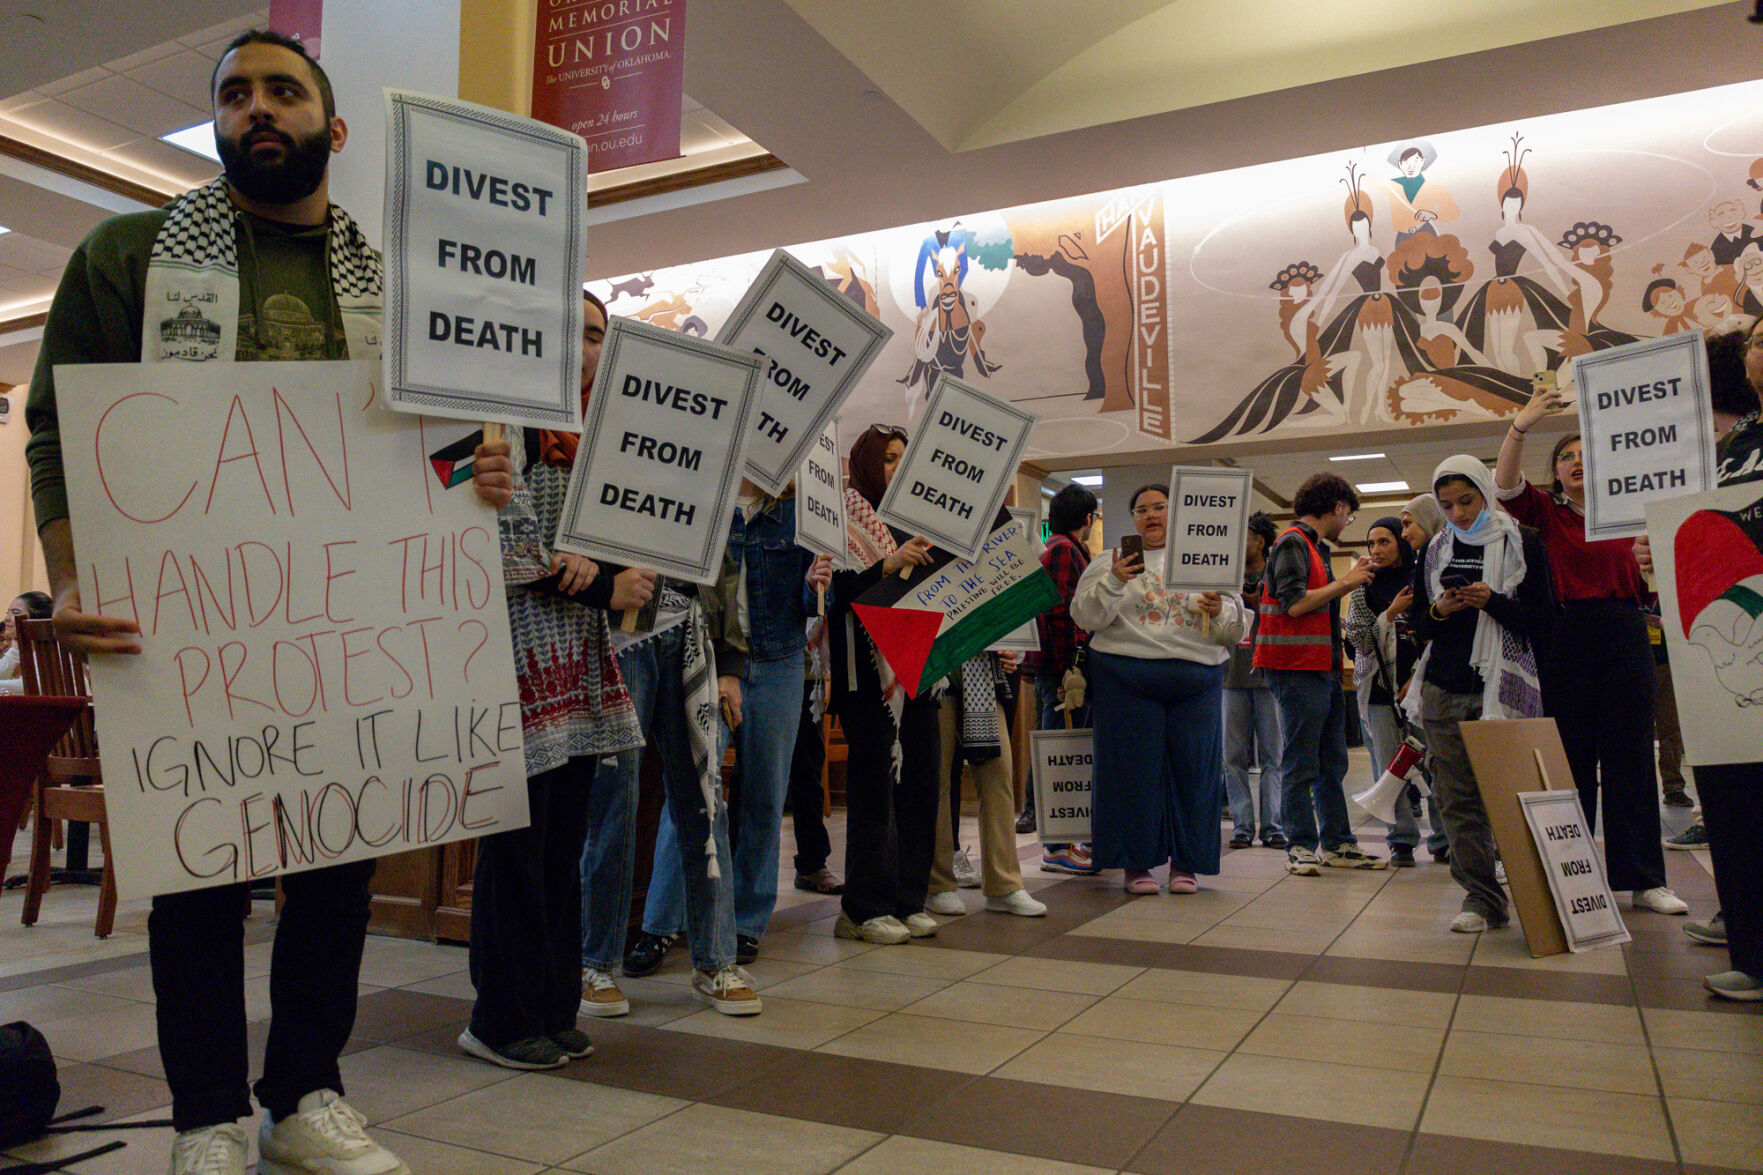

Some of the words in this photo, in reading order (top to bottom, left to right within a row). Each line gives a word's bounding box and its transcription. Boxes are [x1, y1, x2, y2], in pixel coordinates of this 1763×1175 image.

[548, 18, 672, 67] UNION
[558, 62, 609, 83] UNIVERSITY
[571, 119, 595, 133] open
[595, 112, 610, 126] 24
[612, 109, 639, 122] hours
[425, 159, 553, 217] DIVEST
[438, 238, 537, 287] FROM
[1138, 198, 1163, 434] VAUDEVILLE
[428, 310, 543, 358] DEATH
[766, 302, 847, 366] DIVEST
[621, 374, 728, 420] DIVEST
[1597, 377, 1682, 410] DIVEST
[819, 433, 835, 456] EST
[938, 411, 1008, 452] DIVEST
[1610, 424, 1678, 452] FROM
[619, 431, 702, 471] FROM
[930, 449, 985, 484] FROM
[808, 459, 835, 490] FROM
[1607, 468, 1686, 496] DEATH
[599, 483, 696, 526] DEATH
[807, 495, 839, 528] DEATH
[910, 481, 974, 520] DEATH
[1183, 494, 1237, 508] DIVEST
[1187, 524, 1228, 537] FROM
[916, 574, 952, 607] FROM
[954, 559, 979, 574] TH
[981, 526, 1017, 555] RIVER
[1181, 553, 1229, 566] DEATH
[92, 541, 357, 639] HANDLE
[388, 526, 491, 614] THIS
[940, 593, 958, 609] TO
[958, 573, 985, 594] THE
[988, 550, 1017, 573] SEA
[946, 586, 988, 621] PALESTINE
[989, 570, 1010, 587] WILL
[132, 720, 324, 797] IGNORE
[355, 709, 394, 770] IT
[415, 701, 521, 763] LIKE
[1047, 754, 1093, 766] DEATH
[1052, 780, 1092, 792] FROM
[174, 761, 504, 881] GENOCIDE
[1049, 807, 1091, 818] IVEST
[1545, 824, 1581, 841] DEATH
[1560, 858, 1592, 877] FROM
[1571, 894, 1608, 915] DIVEST
